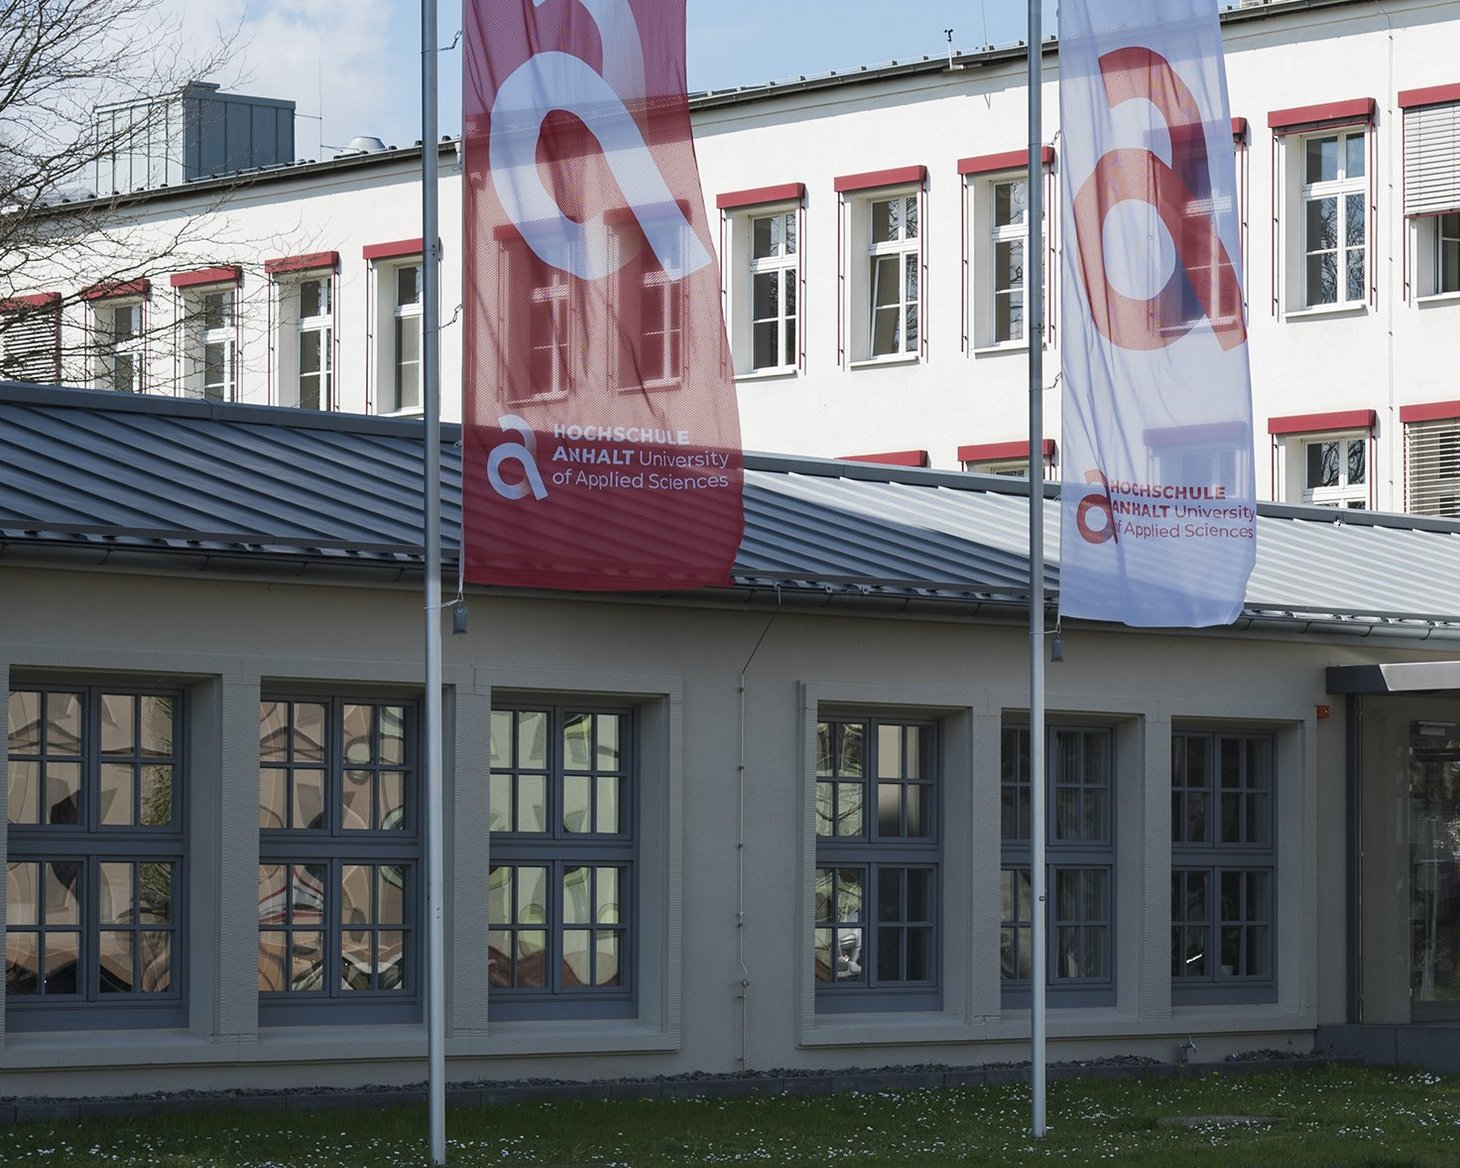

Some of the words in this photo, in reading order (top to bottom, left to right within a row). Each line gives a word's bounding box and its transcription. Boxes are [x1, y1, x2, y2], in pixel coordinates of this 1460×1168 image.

[553, 422, 690, 446] HOCHSCHULE
[552, 446, 635, 466] ANHALT
[639, 450, 730, 469] University
[552, 469, 572, 486] of
[575, 470, 644, 490] Applied
[648, 473, 729, 490] Sciences
[1110, 480, 1226, 500] HOCHSCHULE
[1112, 499, 1171, 518] ANHALT
[1174, 504, 1256, 522] University
[1124, 521, 1180, 539] Applied
[1184, 523, 1254, 539] Sciences
